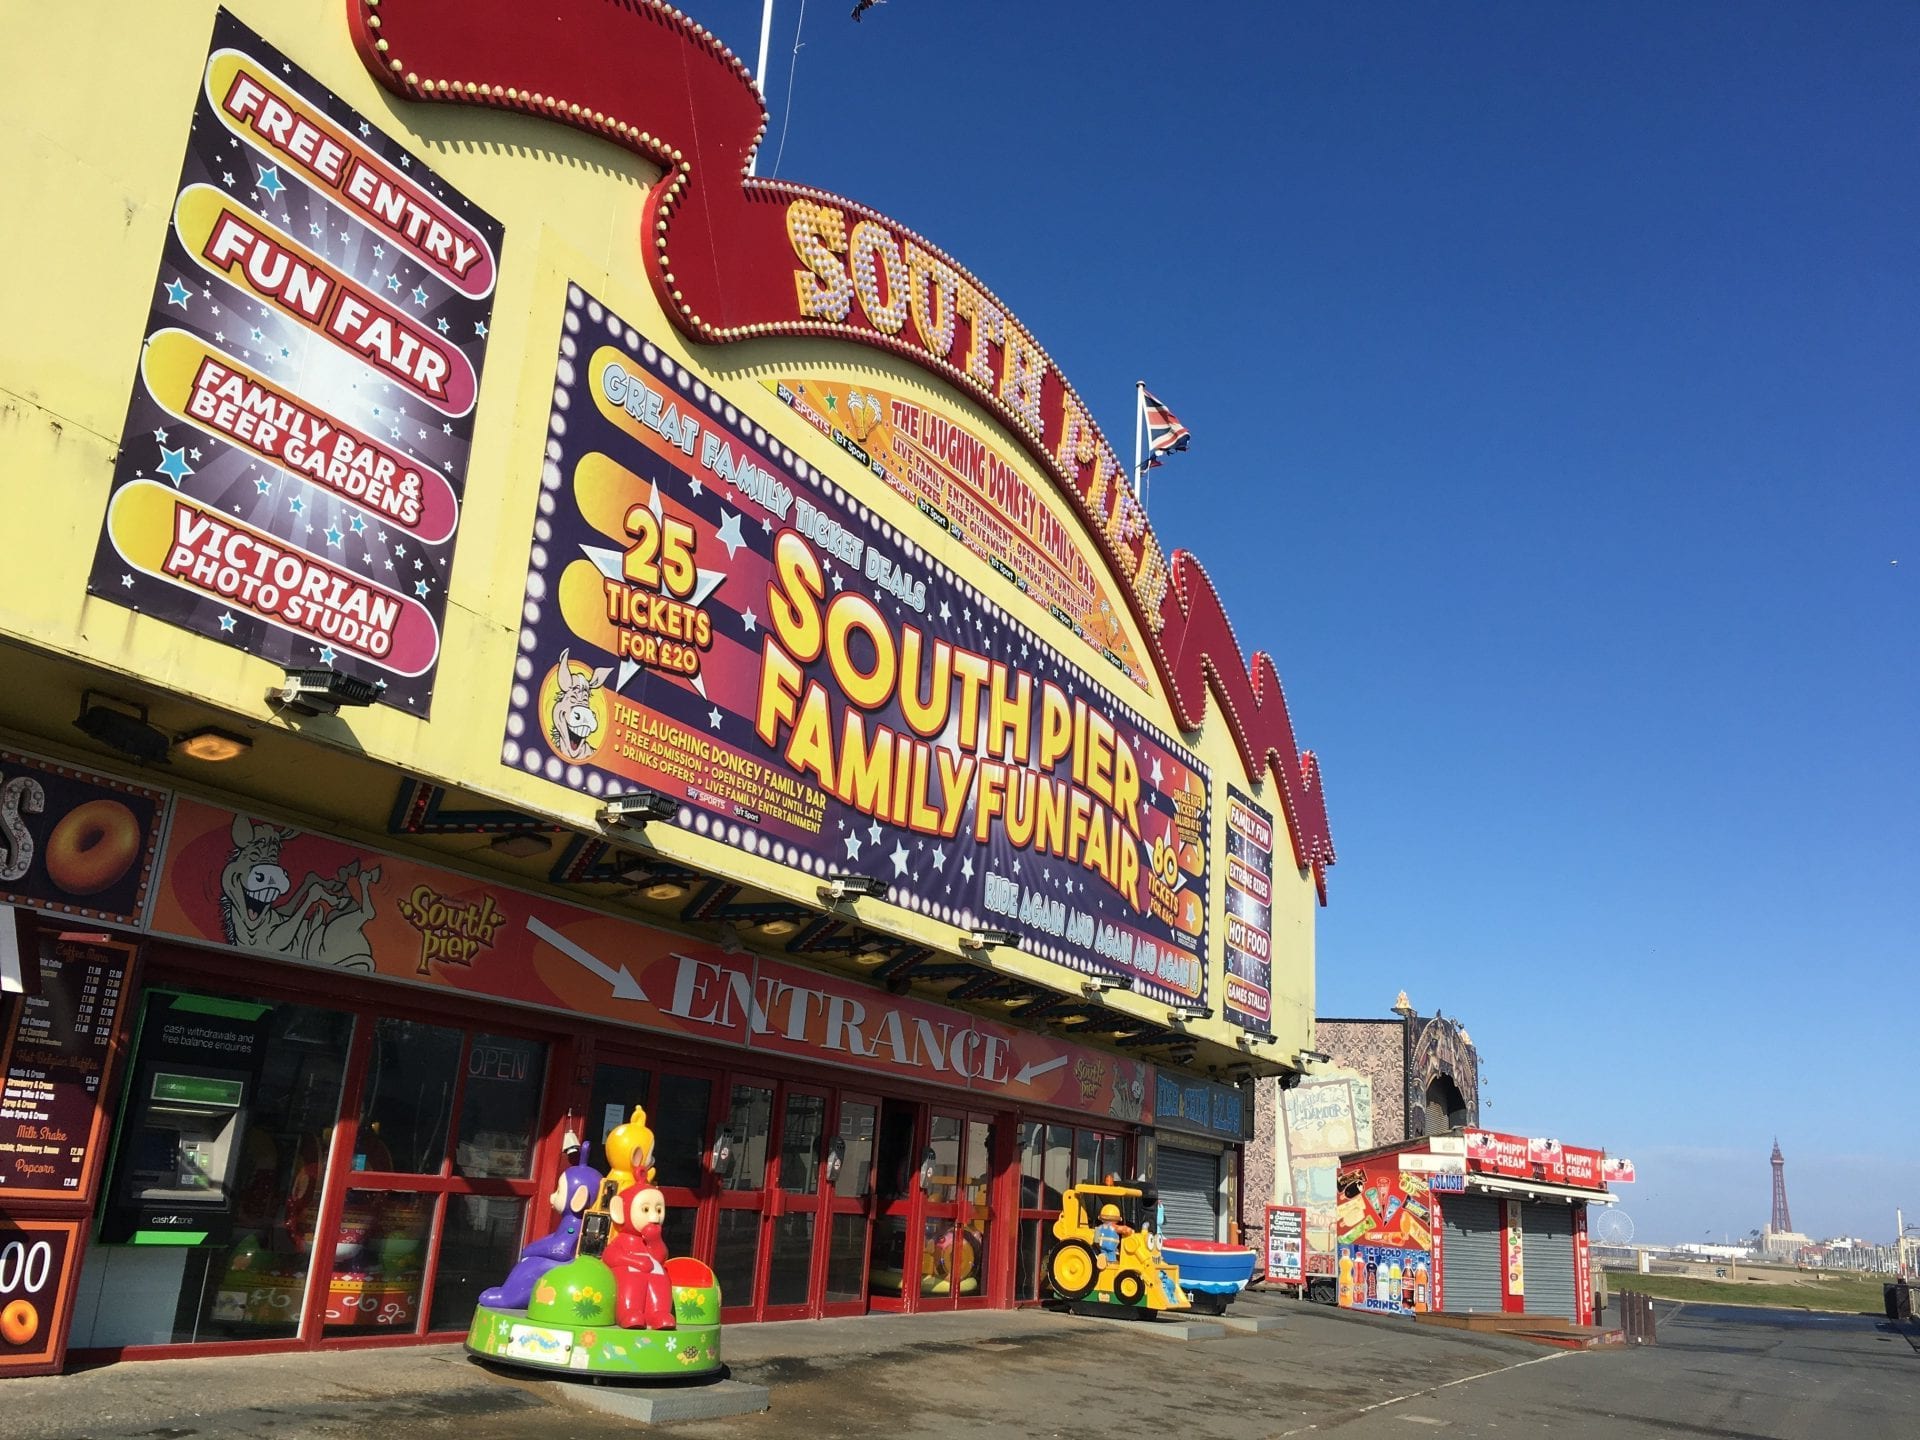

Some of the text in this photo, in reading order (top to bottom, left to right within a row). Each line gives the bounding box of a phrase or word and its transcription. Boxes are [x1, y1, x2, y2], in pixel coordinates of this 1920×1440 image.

[228, 77, 477, 275] FREE ENTRY
[211, 219, 448, 393] FUN FAIR
[198, 366, 420, 501] FAMILY BAR &
[786, 199, 1169, 633] SOUTH PIER
[190, 389, 420, 525] BEER GARDENS
[602, 361, 926, 613] GREAT FAMILY TICKET DEALS
[891, 400, 1097, 599] THE LAUGHING DONKEY FAMILY BAR
[778, 385, 793, 405] sky
[793, 399, 831, 435] SPORTS
[836, 431, 847, 444] BT
[847, 439, 867, 463] Sport
[872, 460, 885, 479] sky
[885, 473, 915, 501] SPORTS
[920, 499, 930, 511] BT
[930, 507, 947, 527] Sport
[950, 523, 962, 541] sky
[962, 534, 987, 560] SPORTS
[991, 557, 1001, 570] BT
[1000, 562, 1014, 581] Sport
[1017, 576, 1027, 593] sky
[1026, 585, 1049, 609] SPORTS
[1059, 611, 1071, 628] Sport
[1082, 630, 1101, 652] SPORTS
[893, 436, 1092, 616] LIVE FAMILY ENTERTAINMENT OPEN DAILY UNTIL LATE
[907, 470, 941, 507] QUIZZES
[946, 500, 968, 527] PRIZE
[969, 520, 1007, 561] GIVEAWAYS
[1009, 553, 1023, 575] AND
[1045, 577, 1062, 603] MUCH
[178, 510, 398, 631] VICTORIAN
[624, 504, 696, 596] 25
[168, 550, 390, 655] PHOTO STUDIO
[606, 581, 709, 645] TICKETS
[619, 629, 698, 673] FOR £20
[768, 528, 1143, 840] SOUTH PIER
[613, 701, 827, 810] THE LAUGHING DONKEY FAMILY BAR
[625, 728, 823, 823] FREE ADMISSION OPEN EVERY DAY UNTIL LATE
[756, 634, 1141, 911] FAMILY FUNFAIR
[622, 744, 822, 835] DRINKS OFFERS LIVE FAMILY ENTERTAINMENT
[699, 791, 726, 809] SPORTS
[1230, 804, 1253, 836] FAMILY
[1254, 824, 1270, 846] FUN
[1152, 834, 1178, 882] 80
[1229, 863, 1268, 899] EXTREME RIDES
[411, 884, 496, 948] South
[1147, 872, 1179, 918] TICKETS
[1150, 896, 1162, 918] FOR
[416, 928, 480, 976] pier
[984, 872, 1019, 918] RIDE
[1019, 886, 1066, 937] AGAIN
[1066, 907, 1095, 950] AND
[1093, 920, 1134, 966] AGAIN
[1133, 936, 1157, 975] AND
[1157, 946, 1191, 990] AGAIN
[1228, 920, 1246, 947] HOT
[1246, 930, 1268, 958] FOOD
[659, 952, 1011, 1086] ENTRANCE
[1227, 980, 1268, 1013] GAMES STALLS
[162, 1034, 251, 1054] free balance enquiries
[164, 1025, 254, 1043] cash withdrawals and
[469, 1050, 526, 1080] OPEN
[1076, 1058, 1104, 1086] South
[1080, 1079, 1098, 1107] pier
[16, 1125, 68, 1141] Milk Shake
[1497, 1142, 1527, 1157] WHIPPY
[1565, 1153, 1591, 1167] WHIPPY
[15, 1159, 55, 1179] Popcorn
[1436, 1175, 1462, 1190] SLUSH
[1497, 1154, 1526, 1169] CREAM
[1553, 1163, 1565, 1175] ICE
[1566, 1165, 1591, 1179] CREAM
[1366, 1247, 1401, 1257] ICE COLD
[1433, 1204, 1442, 1309] MR WHIPPY
[1581, 1246, 1590, 1312] WHIPPY
[1366, 1299, 1400, 1311] DRINKS
